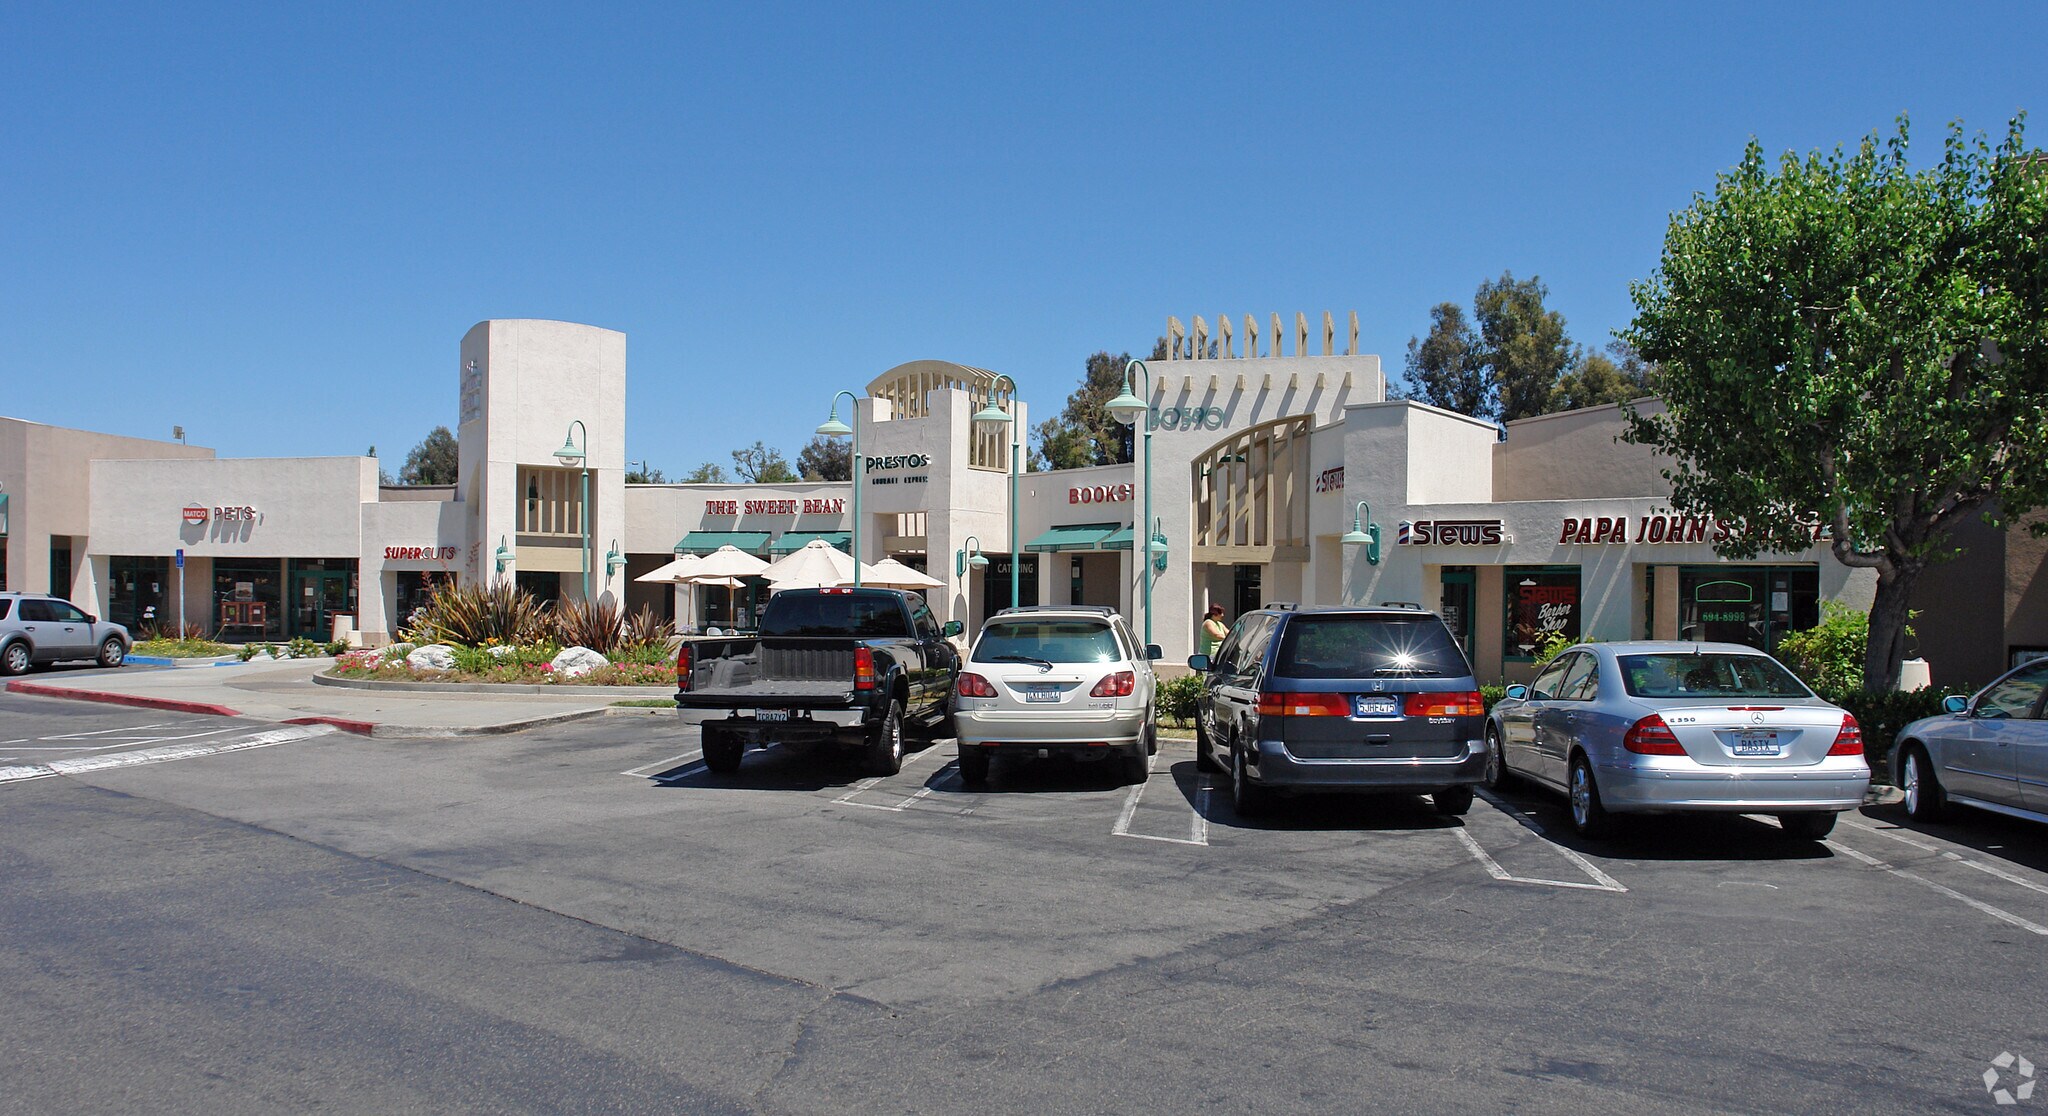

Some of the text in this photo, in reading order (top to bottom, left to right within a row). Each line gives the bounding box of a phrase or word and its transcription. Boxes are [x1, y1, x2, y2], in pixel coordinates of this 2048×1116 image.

[866, 454, 930, 474] PRESTOS
[214, 506, 254, 520] PETS
[706, 498, 844, 515] THE SWEET BEAN
[1559, 517, 1627, 544] PAPA
[383, 546, 457, 560] SUPERCUTS
[998, 563, 1034, 574] CATING
[1537, 602, 1572, 619] Barber
[1539, 616, 1568, 632] Shop
